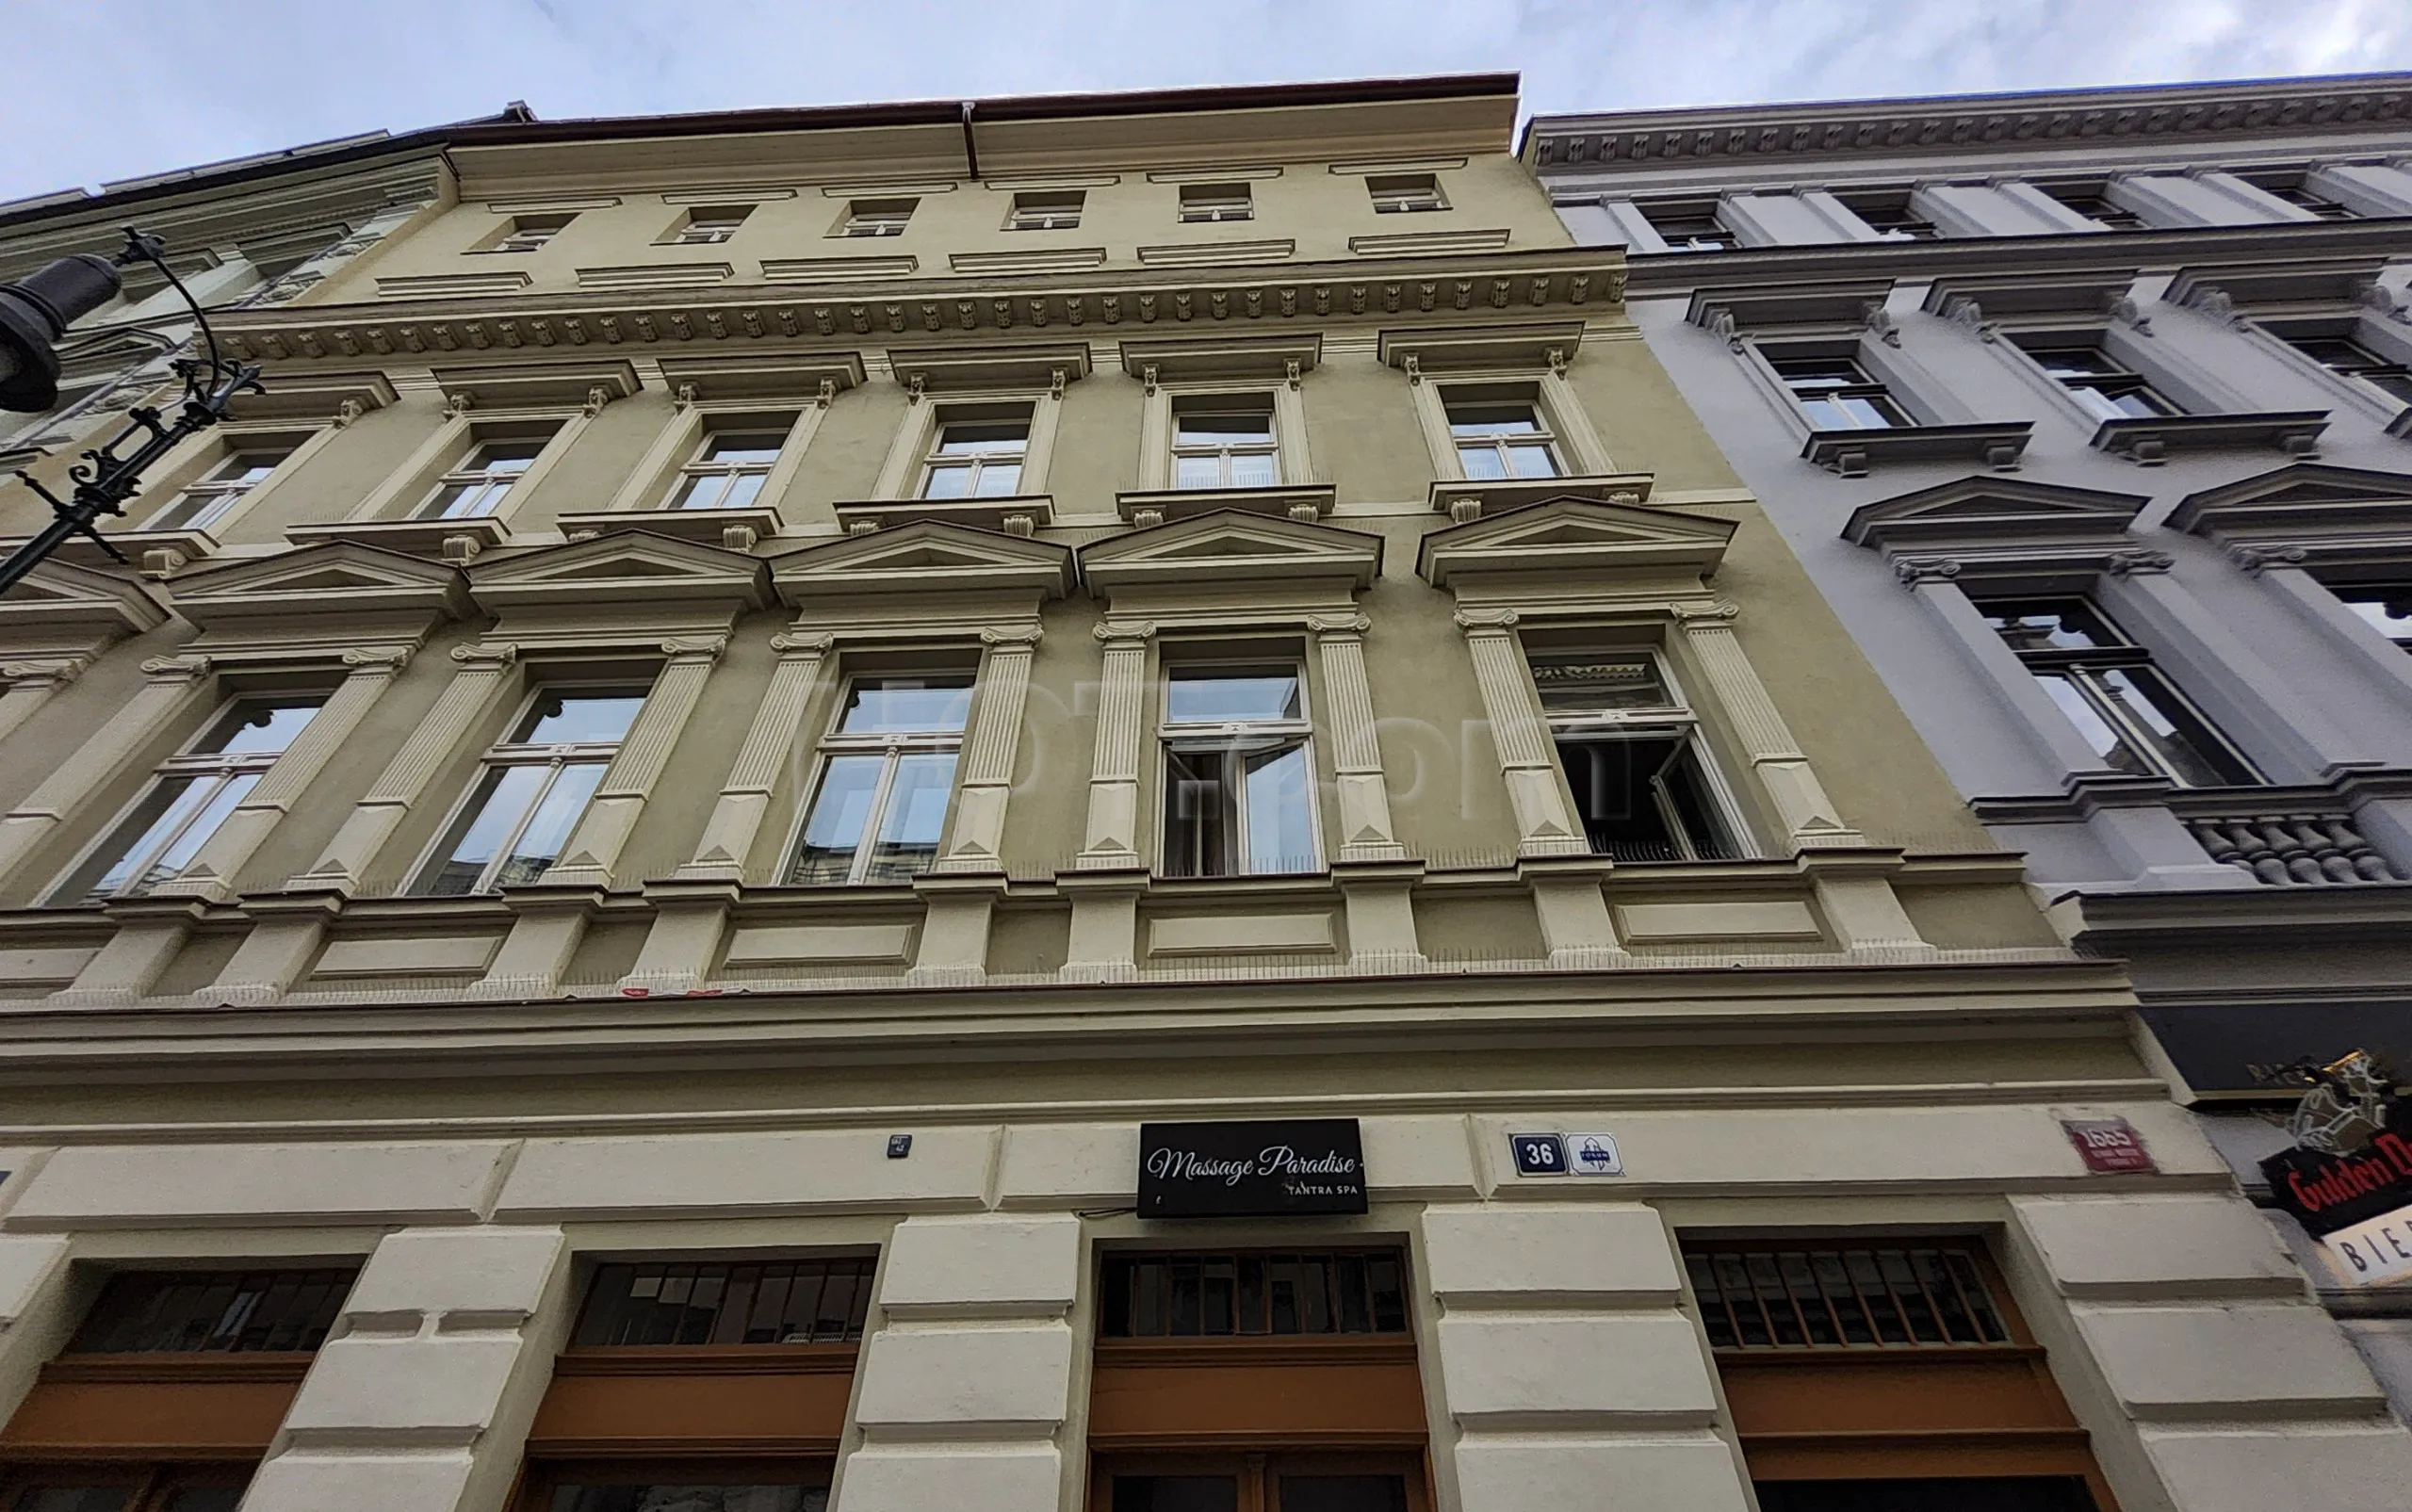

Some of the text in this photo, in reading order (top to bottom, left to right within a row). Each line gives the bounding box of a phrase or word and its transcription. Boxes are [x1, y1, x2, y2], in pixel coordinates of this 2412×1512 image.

[1147, 1145, 1355, 1187] Massage Paradise
[1525, 1143, 1555, 1165] 36
[2289, 1132, 2412, 1212] Gulden D
[1288, 1184, 1359, 1196] TANTRA SPA
[2339, 1219, 2412, 1273] BIE
